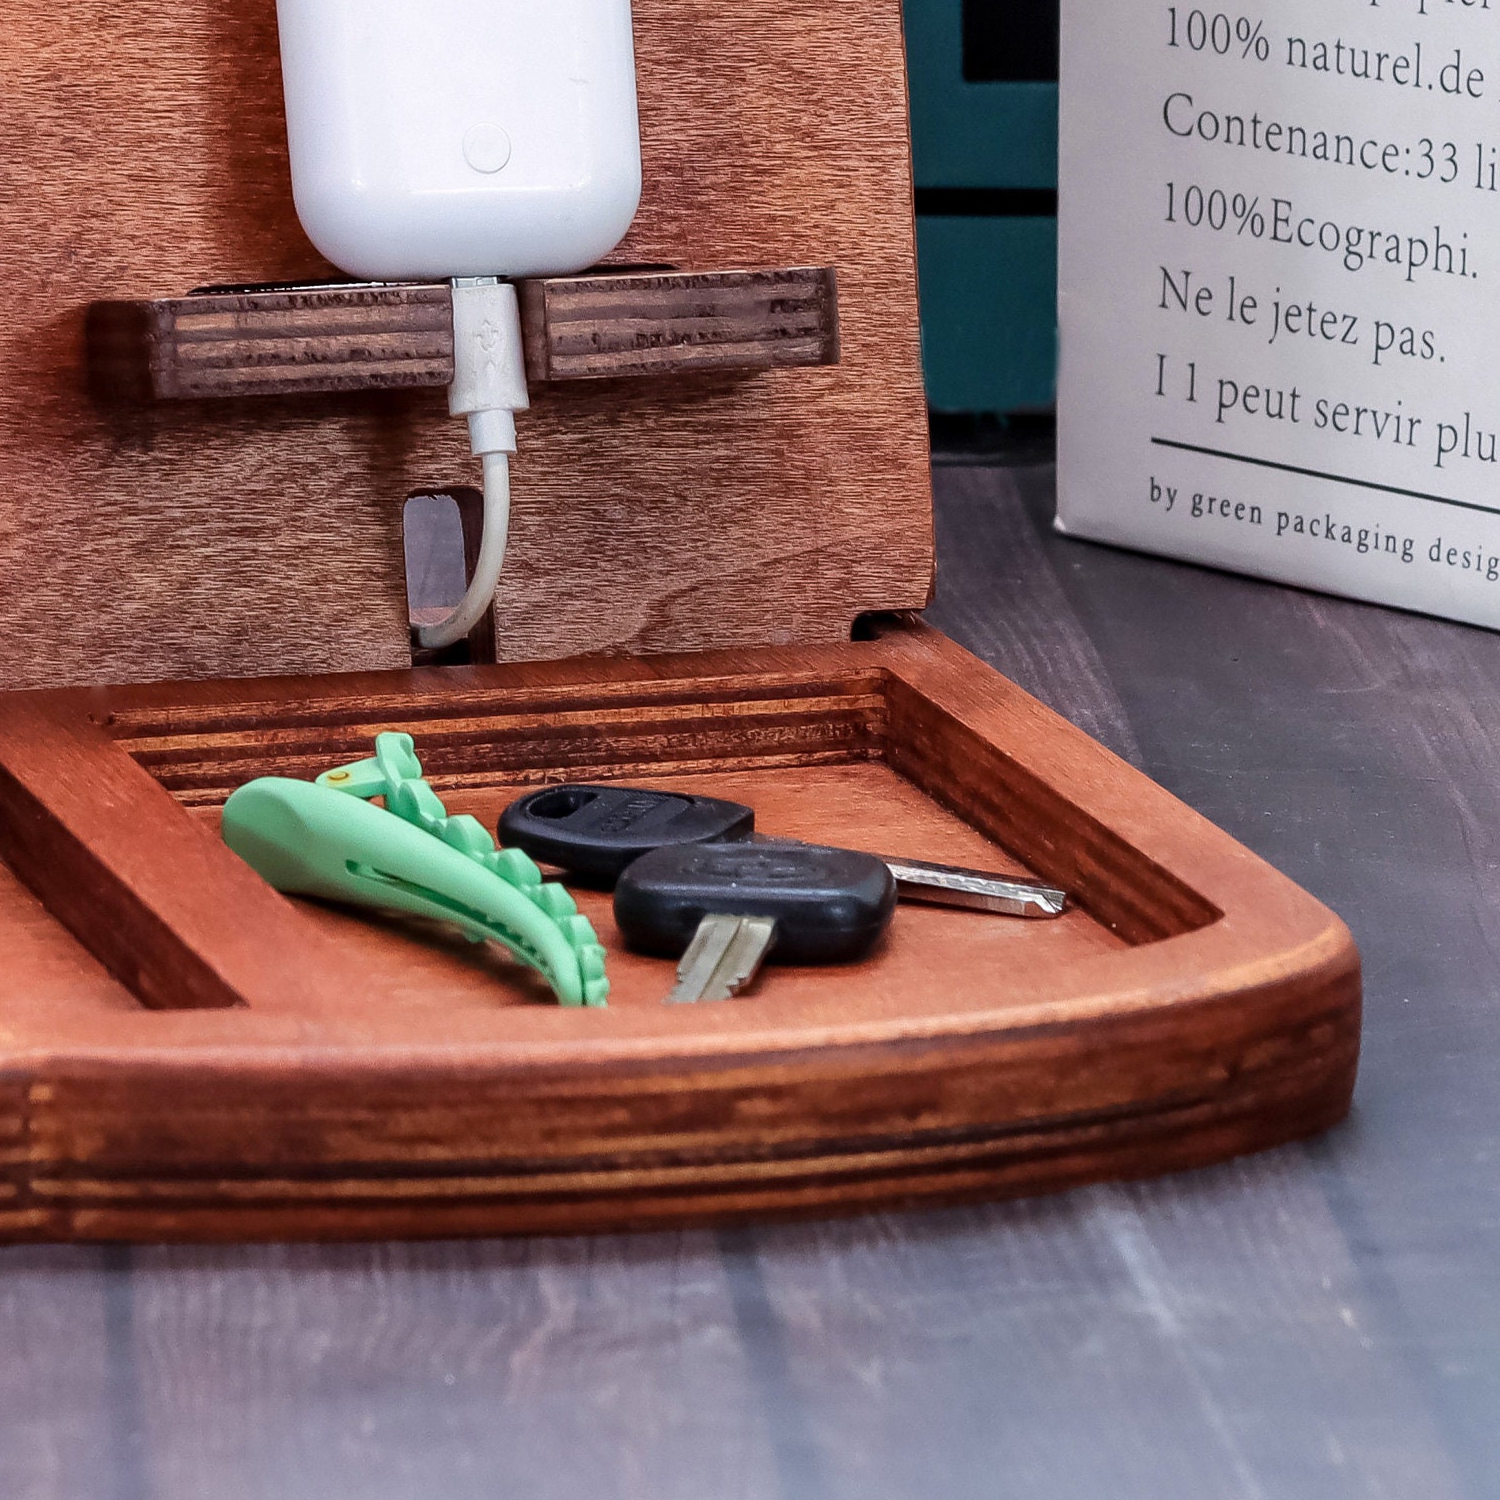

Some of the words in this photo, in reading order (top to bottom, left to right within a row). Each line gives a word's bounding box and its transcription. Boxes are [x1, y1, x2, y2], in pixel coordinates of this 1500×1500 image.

[1168, 8, 1269, 61] 100%
[1286, 37, 1484, 98] naturel.de
[1162, 92, 1459, 183] Contenance:33
[1475, 143, 1497, 191] li
[1164, 182, 1479, 282] 100%Ecographi.
[1159, 266, 1212, 316] Ne
[1227, 276, 1257, 325] le
[1268, 287, 1357, 344] jetez
[1372, 321, 1444, 365] pas.
[1215, 379, 1300, 423] peut
[1314, 399, 1421, 446] servir
[1434, 412, 1497, 468] plu
[1150, 477, 1177, 511] by
[1191, 494, 1261, 524] green
[1276, 508, 1415, 564] packaging
[1429, 537, 1499, 581] desig
